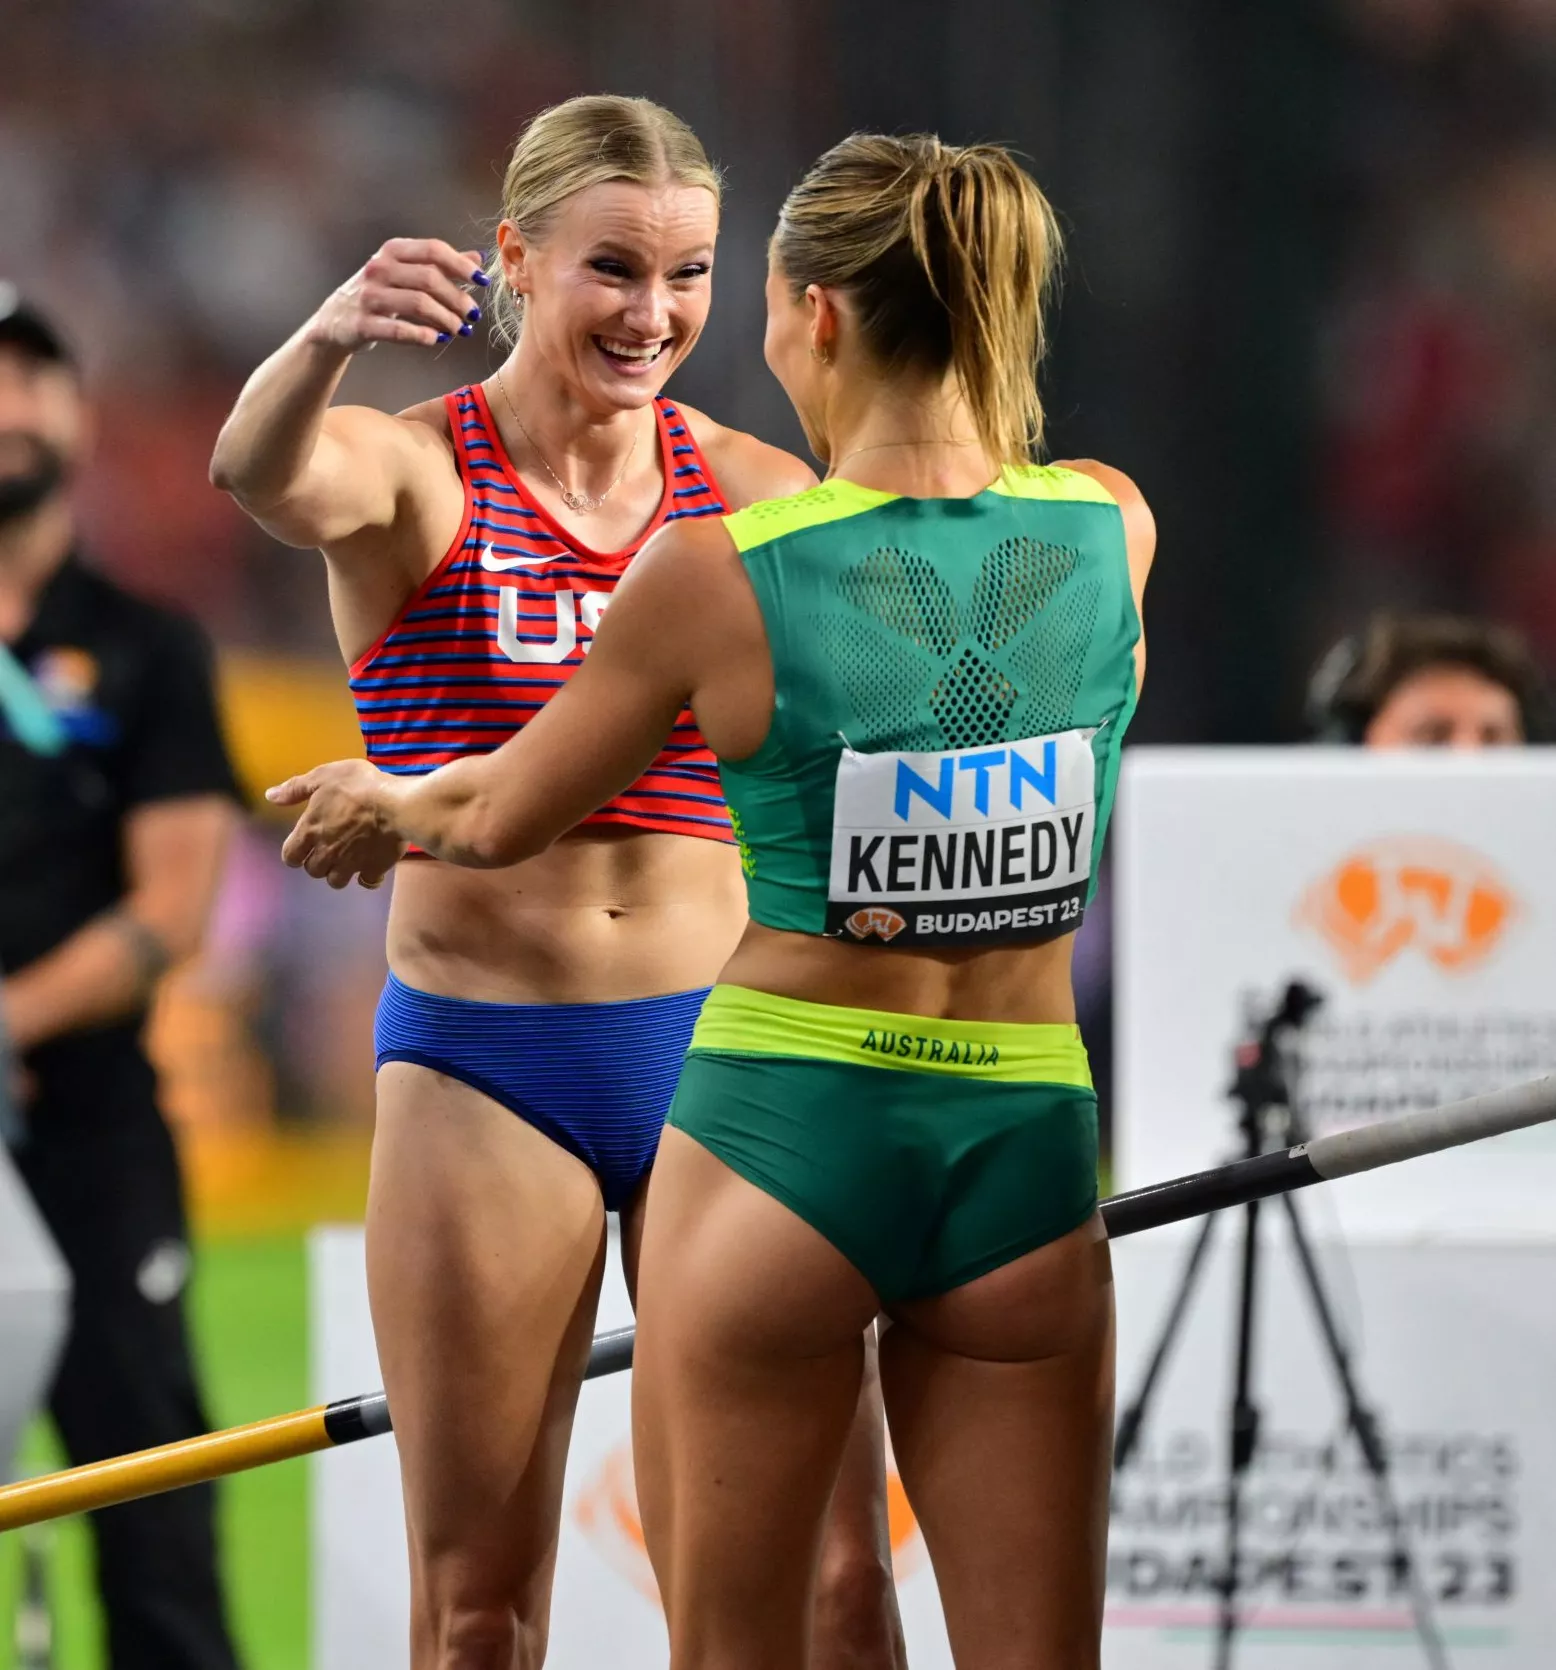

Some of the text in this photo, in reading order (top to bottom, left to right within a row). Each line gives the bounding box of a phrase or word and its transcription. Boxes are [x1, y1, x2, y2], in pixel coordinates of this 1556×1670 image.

[894, 740, 1056, 822] NTN
[847, 812, 1084, 893] KENNEDY
[915, 896, 1080, 934] BUDAPEST 23
[861, 1029, 999, 1066] AUSTRALIA
